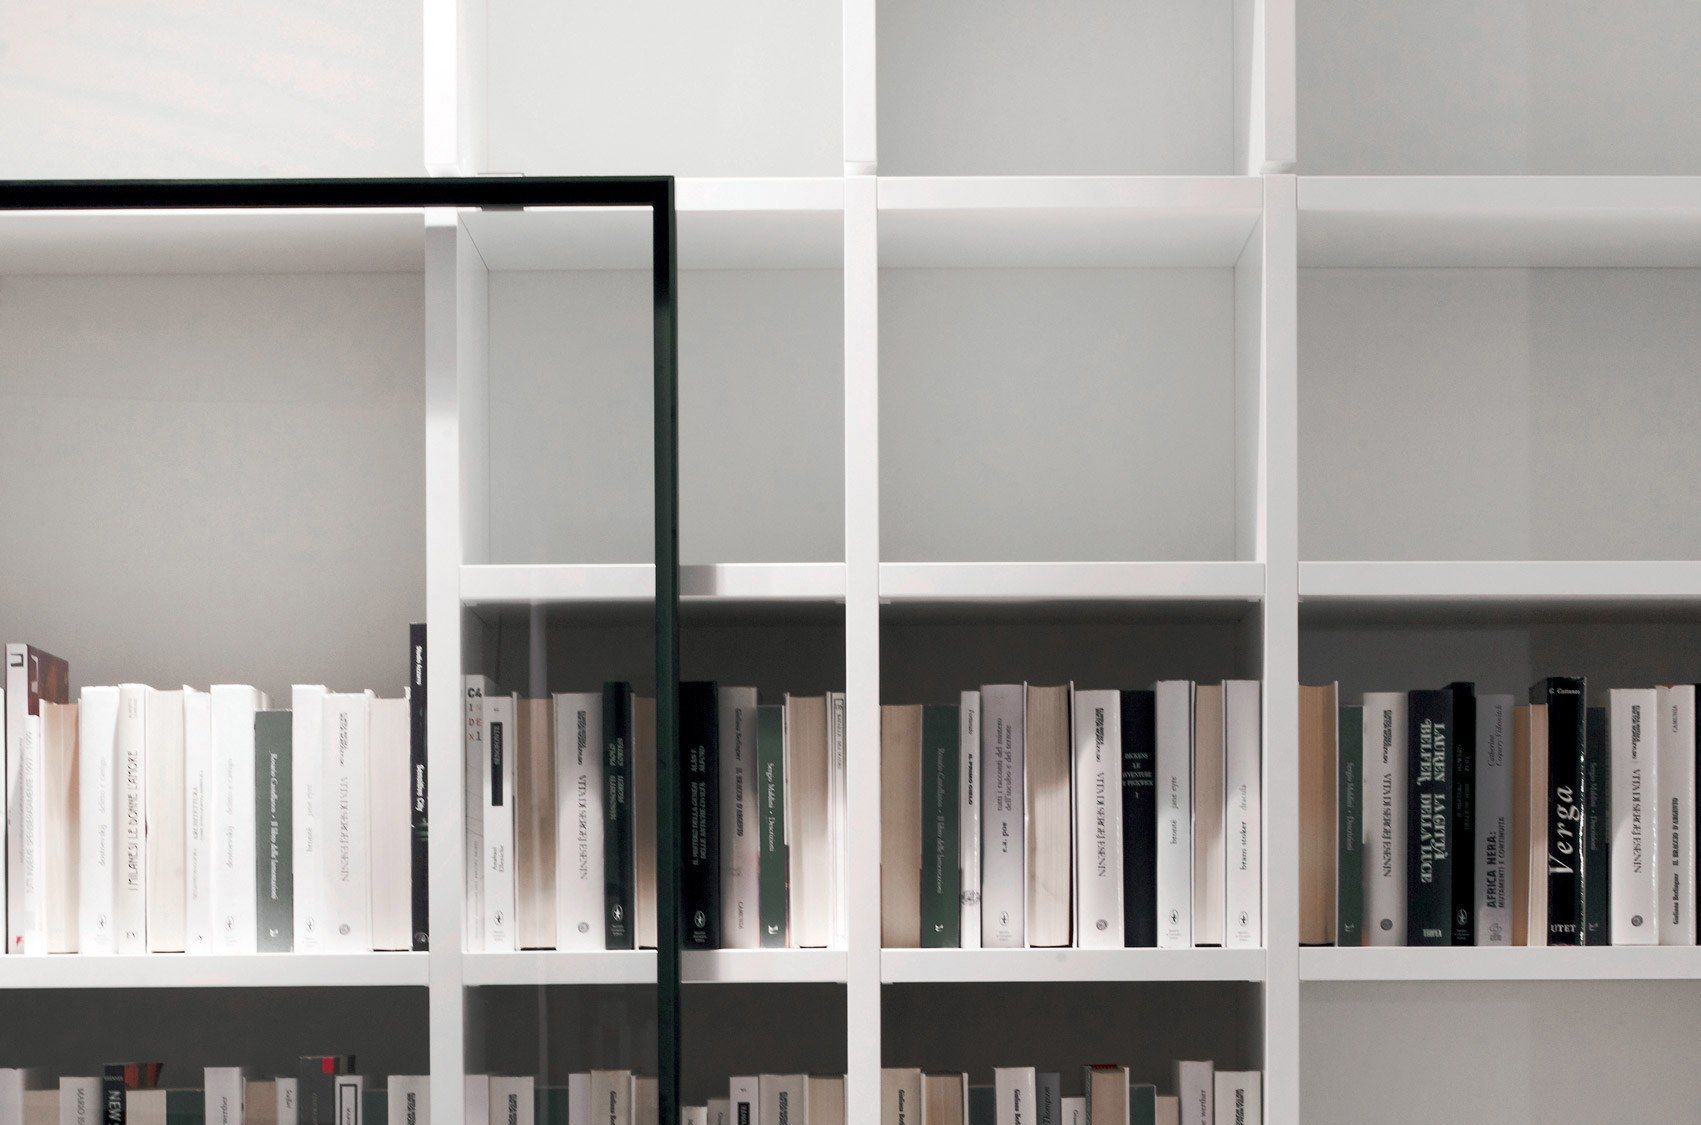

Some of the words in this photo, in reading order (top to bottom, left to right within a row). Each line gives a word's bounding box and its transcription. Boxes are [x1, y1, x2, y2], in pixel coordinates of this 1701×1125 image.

[1433, 723, 1446, 783] LAUREN
[1383, 773, 1392, 797] VITA
[1633, 768, 1641, 792] VITA
[1420, 793, 1433, 842] DELLA
[1433, 794, 1446, 813] LA
[1239, 821, 1247, 846] stoker
[1431, 814, 1449, 861] CITTÀ
[1486, 831, 1496, 865] NERA:
[1549, 785, 1580, 876] Verga
[1239, 849, 1247, 870] bram
[1383, 841, 1392, 878] ESENIN
[1420, 844, 1433, 884] LUCE
[1634, 837, 1642, 874] ESENIN
[1486, 870, 1496, 908] AFRICA
[1550, 924, 1577, 932] UTET
[108, 1090, 122, 1122] NEW
[1043, 1086, 1052, 1125] Thompson
